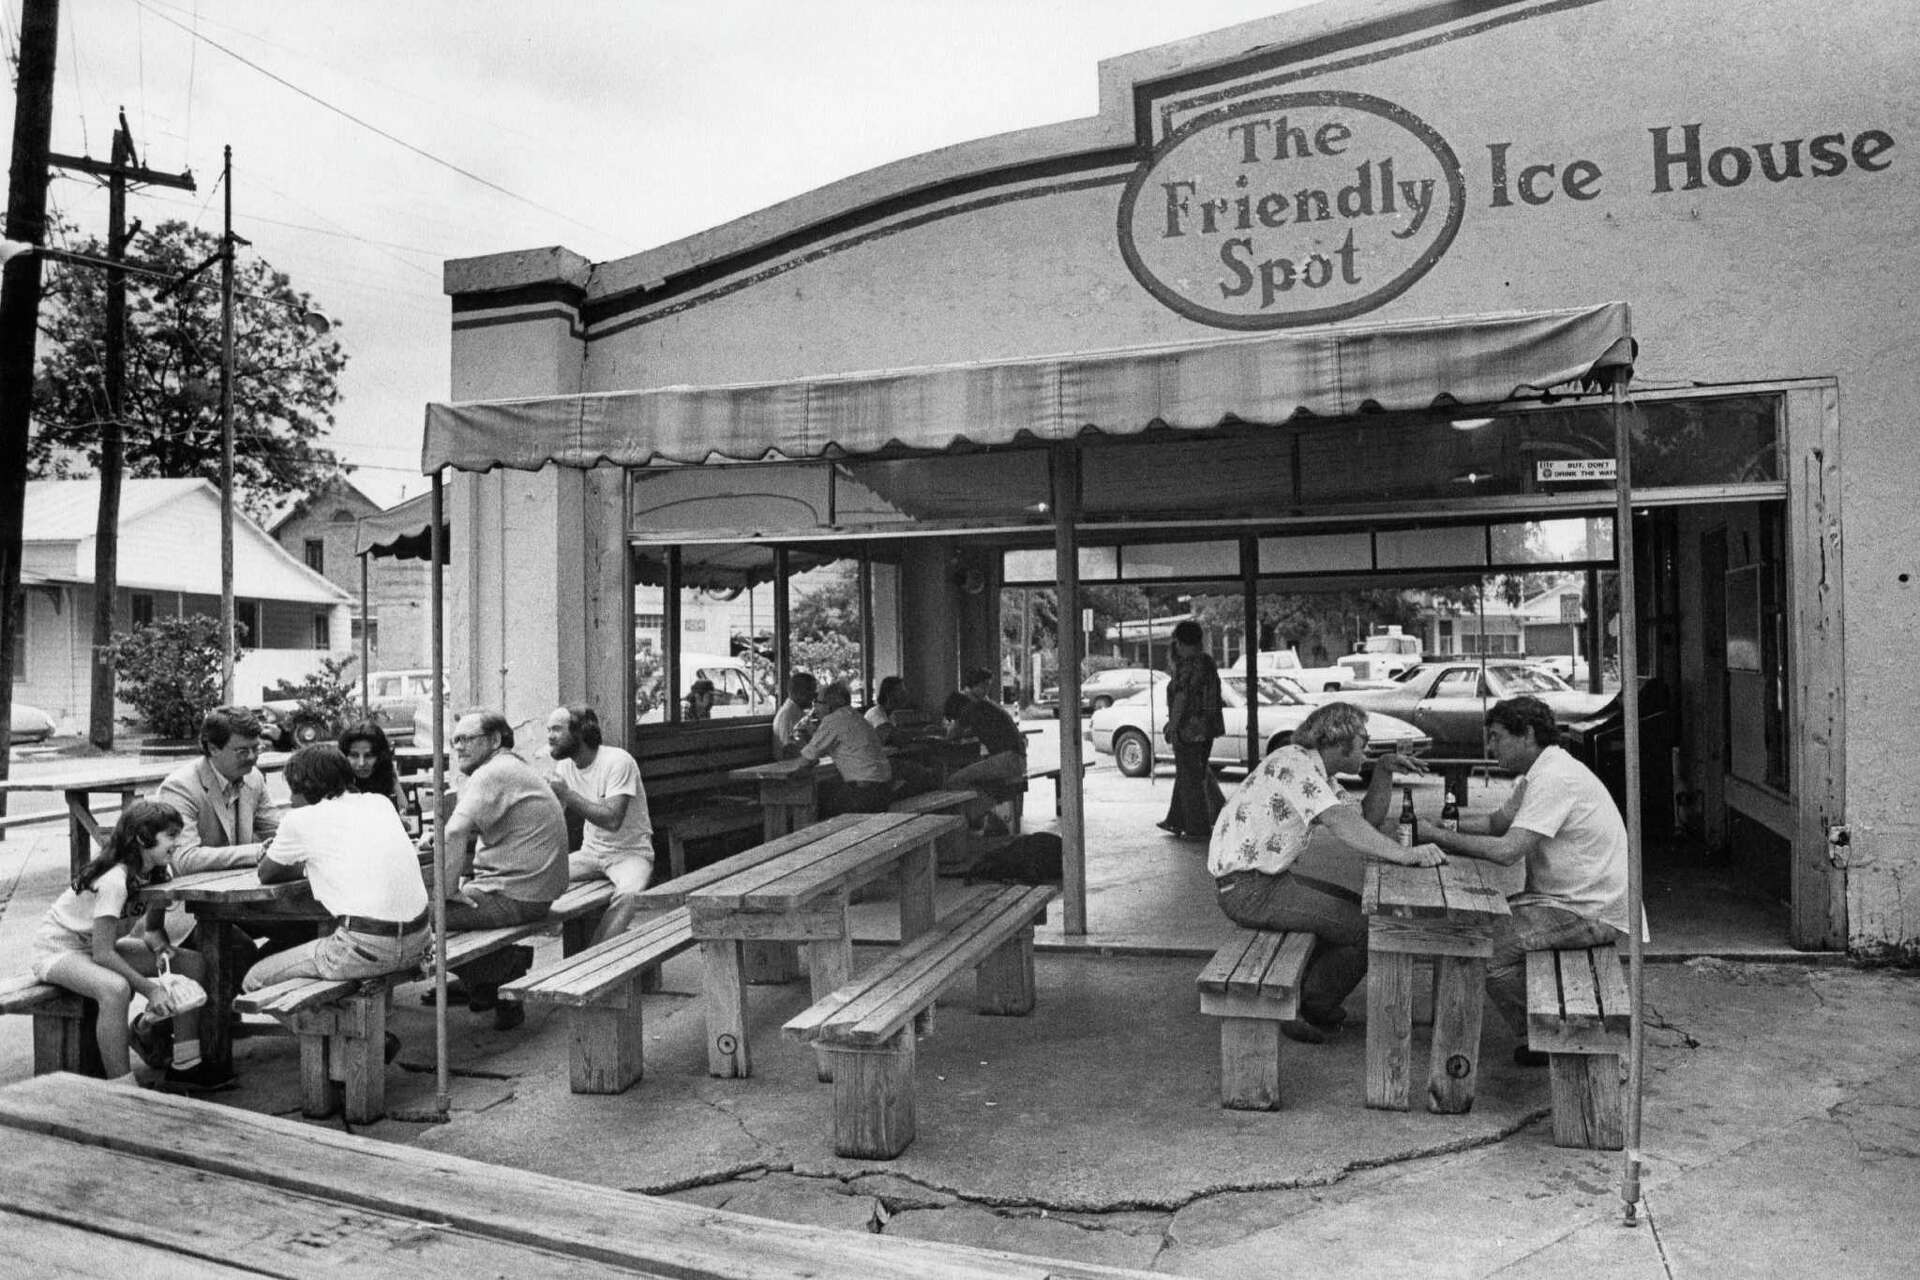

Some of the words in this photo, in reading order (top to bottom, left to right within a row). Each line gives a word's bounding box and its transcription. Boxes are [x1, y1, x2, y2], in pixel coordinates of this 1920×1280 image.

[1228, 115, 1352, 163] The
[1485, 142, 1603, 208] Ice
[1647, 123, 1895, 194] House
[1161, 156, 1436, 239] Friendly
[1219, 227, 1362, 308] Spot
